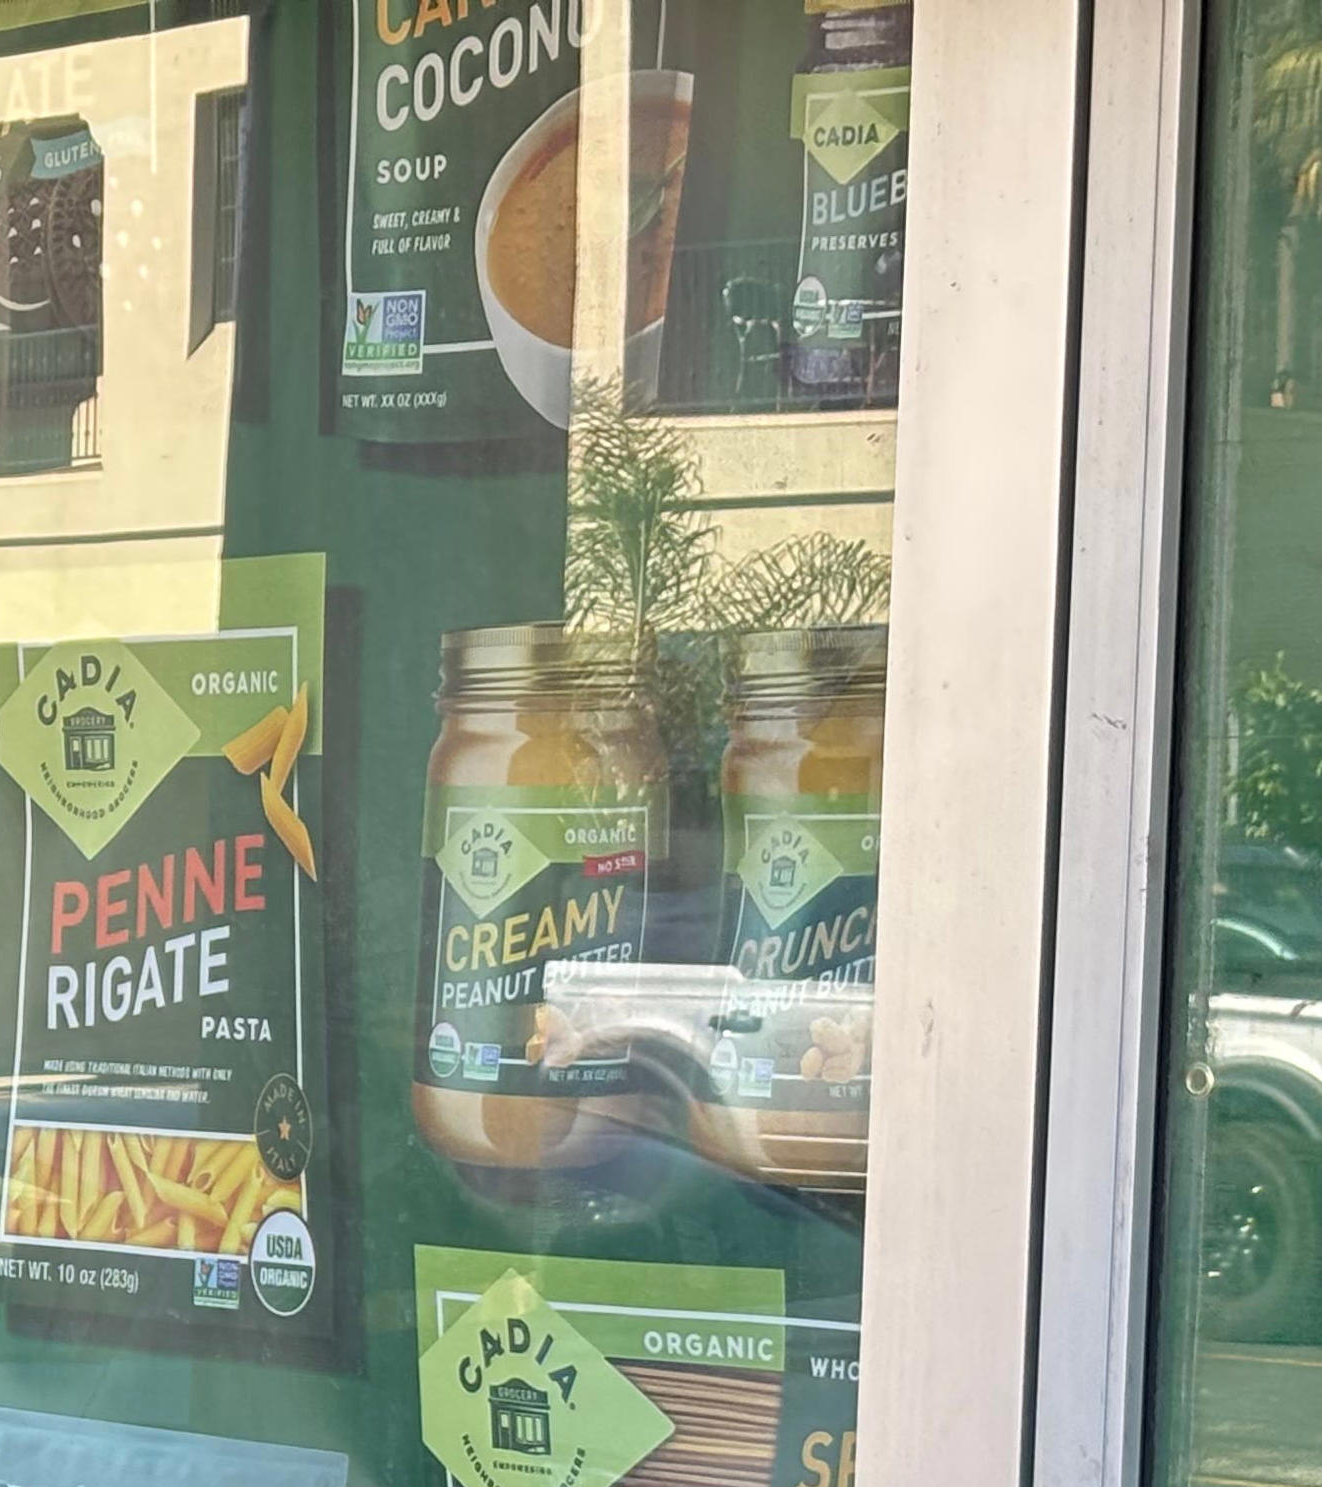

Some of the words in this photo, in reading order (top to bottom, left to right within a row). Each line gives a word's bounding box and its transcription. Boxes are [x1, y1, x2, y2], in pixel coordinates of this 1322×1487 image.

[813, 120, 880, 148] CADIA
[376, 154, 448, 185] SOUP
[411, 207, 450, 228] CREAMY
[372, 237, 395, 255] FULL
[398, 235, 411, 253] OF
[414, 232, 451, 252] FLAVOR
[811, 231, 899, 252] PRESERVES
[385, 312, 418, 327] GMO
[386, 299, 419, 313] NON
[347, 343, 418, 359] VERIFIED
[342, 394, 359, 408] NET
[397, 392, 412, 407] OZ
[36, 654, 138, 728] CADIA
[191, 669, 279, 696] ORGANIC
[461, 822, 513, 856] CADIA
[564, 826, 637, 845] ORGANIC
[761, 830, 810, 865] CADIA
[50, 833, 267, 955] PENNE
[445, 885, 625, 973] CREAMY
[46, 925, 231, 1031] RIGATE
[441, 966, 537, 1010] PEANUT
[541, 942, 633, 991] BUTTER
[200, 1015, 273, 1043] PASTA
[266, 1233, 304, 1260] USDA
[27, 1258, 53, 1283] WT.
[56, 1261, 76, 1285] 10
[78, 1266, 97, 1286] oz
[99, 1263, 140, 1294] (283g)
[259, 1267, 308, 1289] ORGANIC
[458, 1316, 579, 1405] CADIA
[643, 1331, 774, 1362] ORGANIC
